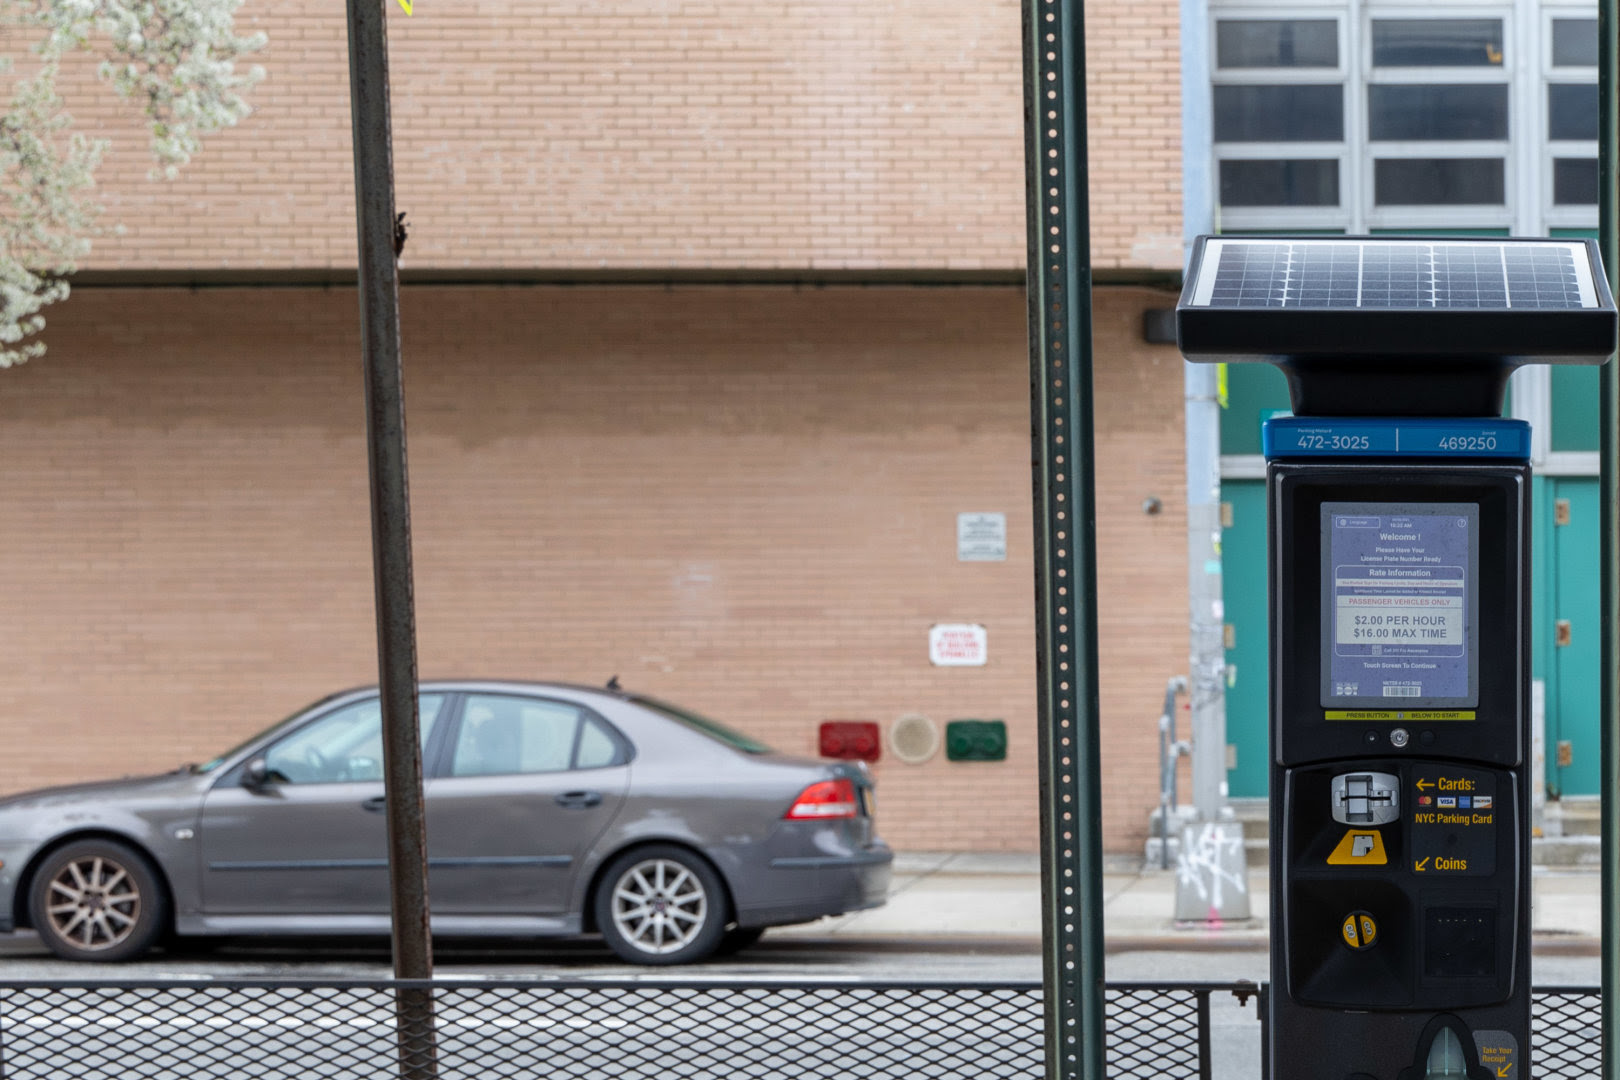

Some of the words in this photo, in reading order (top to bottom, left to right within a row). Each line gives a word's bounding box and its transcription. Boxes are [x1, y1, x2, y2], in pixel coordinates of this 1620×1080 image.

[1297, 435, 1370, 449] 472-3025
[1438, 437, 1497, 450] 469250
[1379, 533, 1416, 541] Welcome
[1369, 569, 1386, 577] Rate
[1387, 569, 1431, 577] Information
[1348, 598, 1393, 606] PASSENGER
[1354, 615, 1383, 626] $2.00
[1386, 616, 1410, 626] PER
[1412, 616, 1446, 626] HOUR
[1353, 628, 1389, 639] $16.00
[1392, 628, 1417, 638] MAX
[1420, 629, 1447, 639] TIME
[1438, 777, 1476, 791] Cards:
[1415, 813, 1435, 824] NYC
[1437, 813, 1470, 826] Parking
[1472, 813, 1493, 824] Card
[1434, 856, 1467, 870] Coins
[1482, 1046, 1497, 1054] Take
